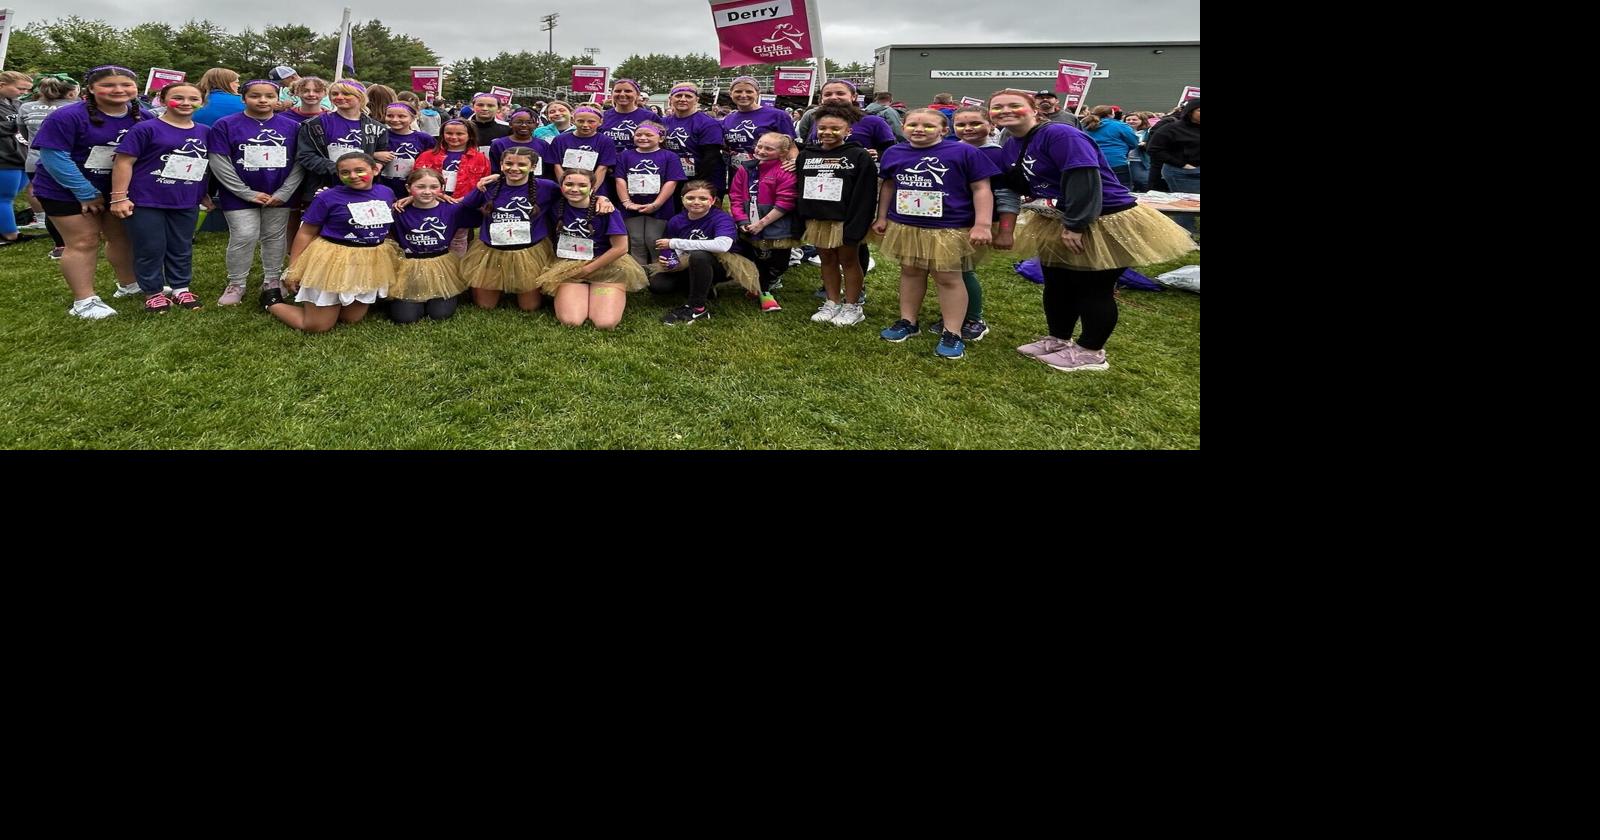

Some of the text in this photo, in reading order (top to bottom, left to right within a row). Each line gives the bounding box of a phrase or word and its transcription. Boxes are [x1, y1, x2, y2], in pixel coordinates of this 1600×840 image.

[727, 6, 779, 22] Derry
[752, 43, 784, 54] Girls
[769, 49, 793, 57] run
[263, 152, 269, 160] 1
[185, 163, 192, 173] 1
[393, 164, 399, 172] 1
[896, 173, 924, 182] Girls
[640, 180, 645, 188] 1
[818, 184, 824, 192] 1
[908, 180, 933, 188] run
[914, 198, 920, 208] 1
[367, 208, 375, 218] 1
[506, 228, 512, 237] 1
[572, 244, 578, 252] 1
